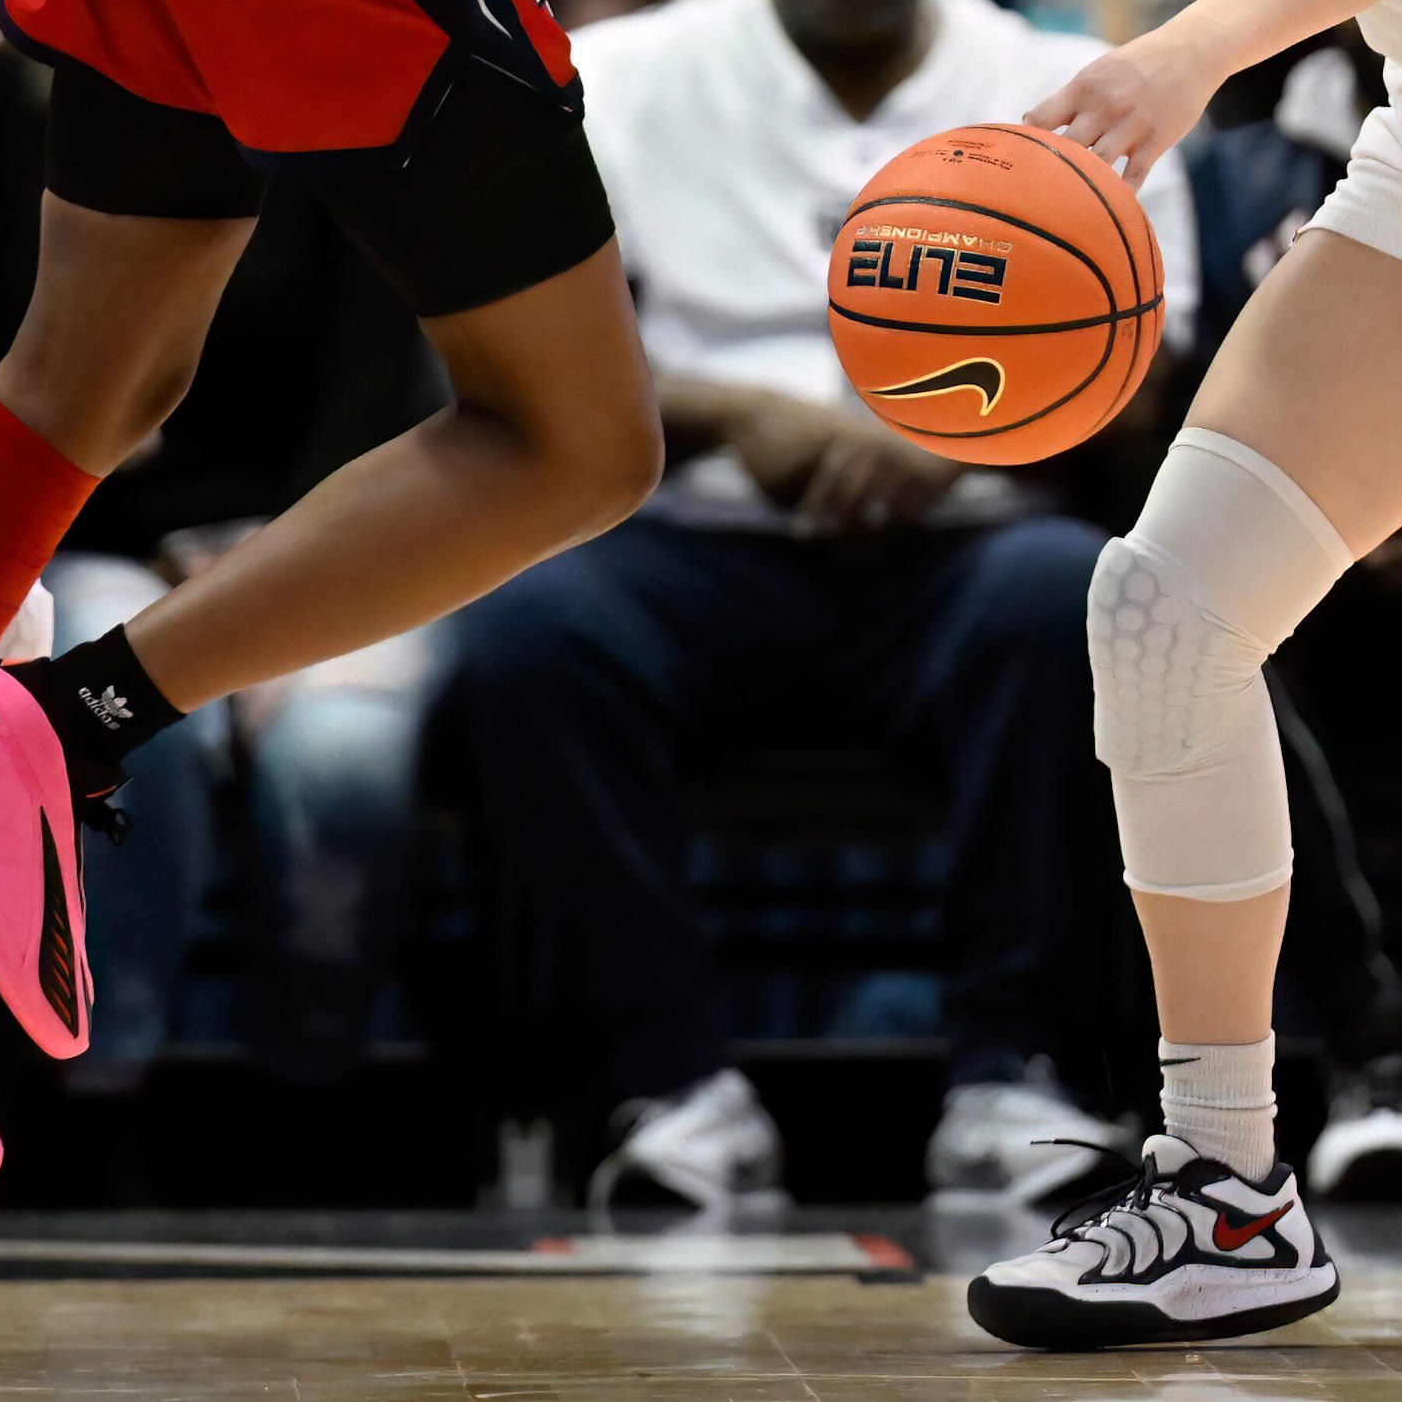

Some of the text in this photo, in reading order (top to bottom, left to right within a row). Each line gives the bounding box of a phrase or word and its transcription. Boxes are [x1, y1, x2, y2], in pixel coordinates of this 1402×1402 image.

[855, 225, 1014, 254] CHAMPIONSHIP
[846, 239, 1008, 306] ELITE
[78, 686, 121, 730] adidas
